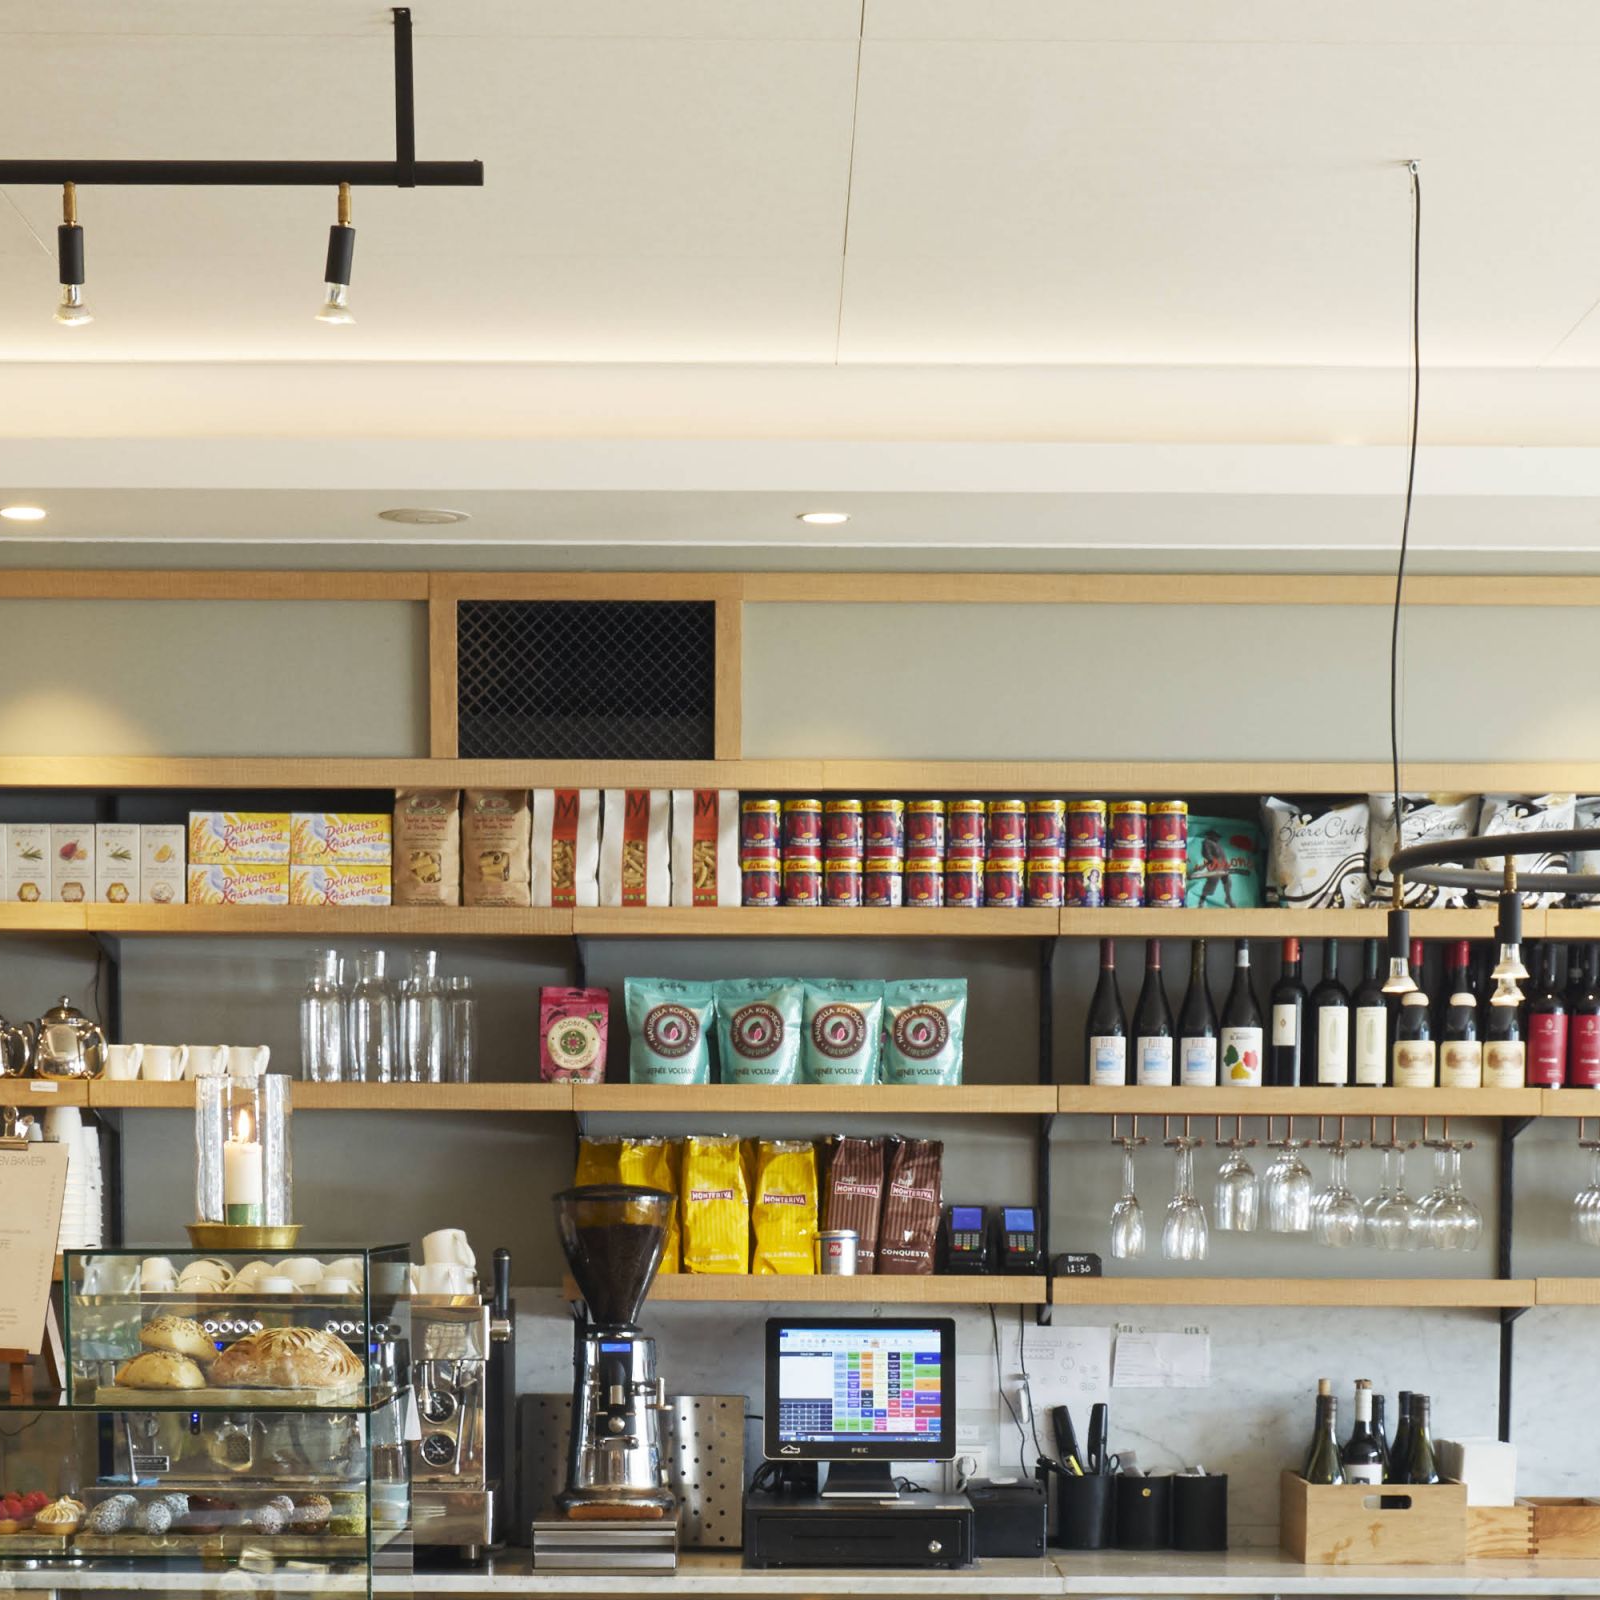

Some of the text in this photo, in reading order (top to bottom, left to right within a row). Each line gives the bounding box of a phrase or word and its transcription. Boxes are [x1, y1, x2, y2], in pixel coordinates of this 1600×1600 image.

[837, 1185, 878, 1196] MONTERIVA
[893, 1187, 933, 1199] MONTERIVA
[692, 1191, 732, 1200] MONTERIVA
[764, 1195, 806, 1204] MONTERIVA
[881, 1248, 930, 1258] CONQUESTA
[1067, 1264, 1091, 1273] 12:30
